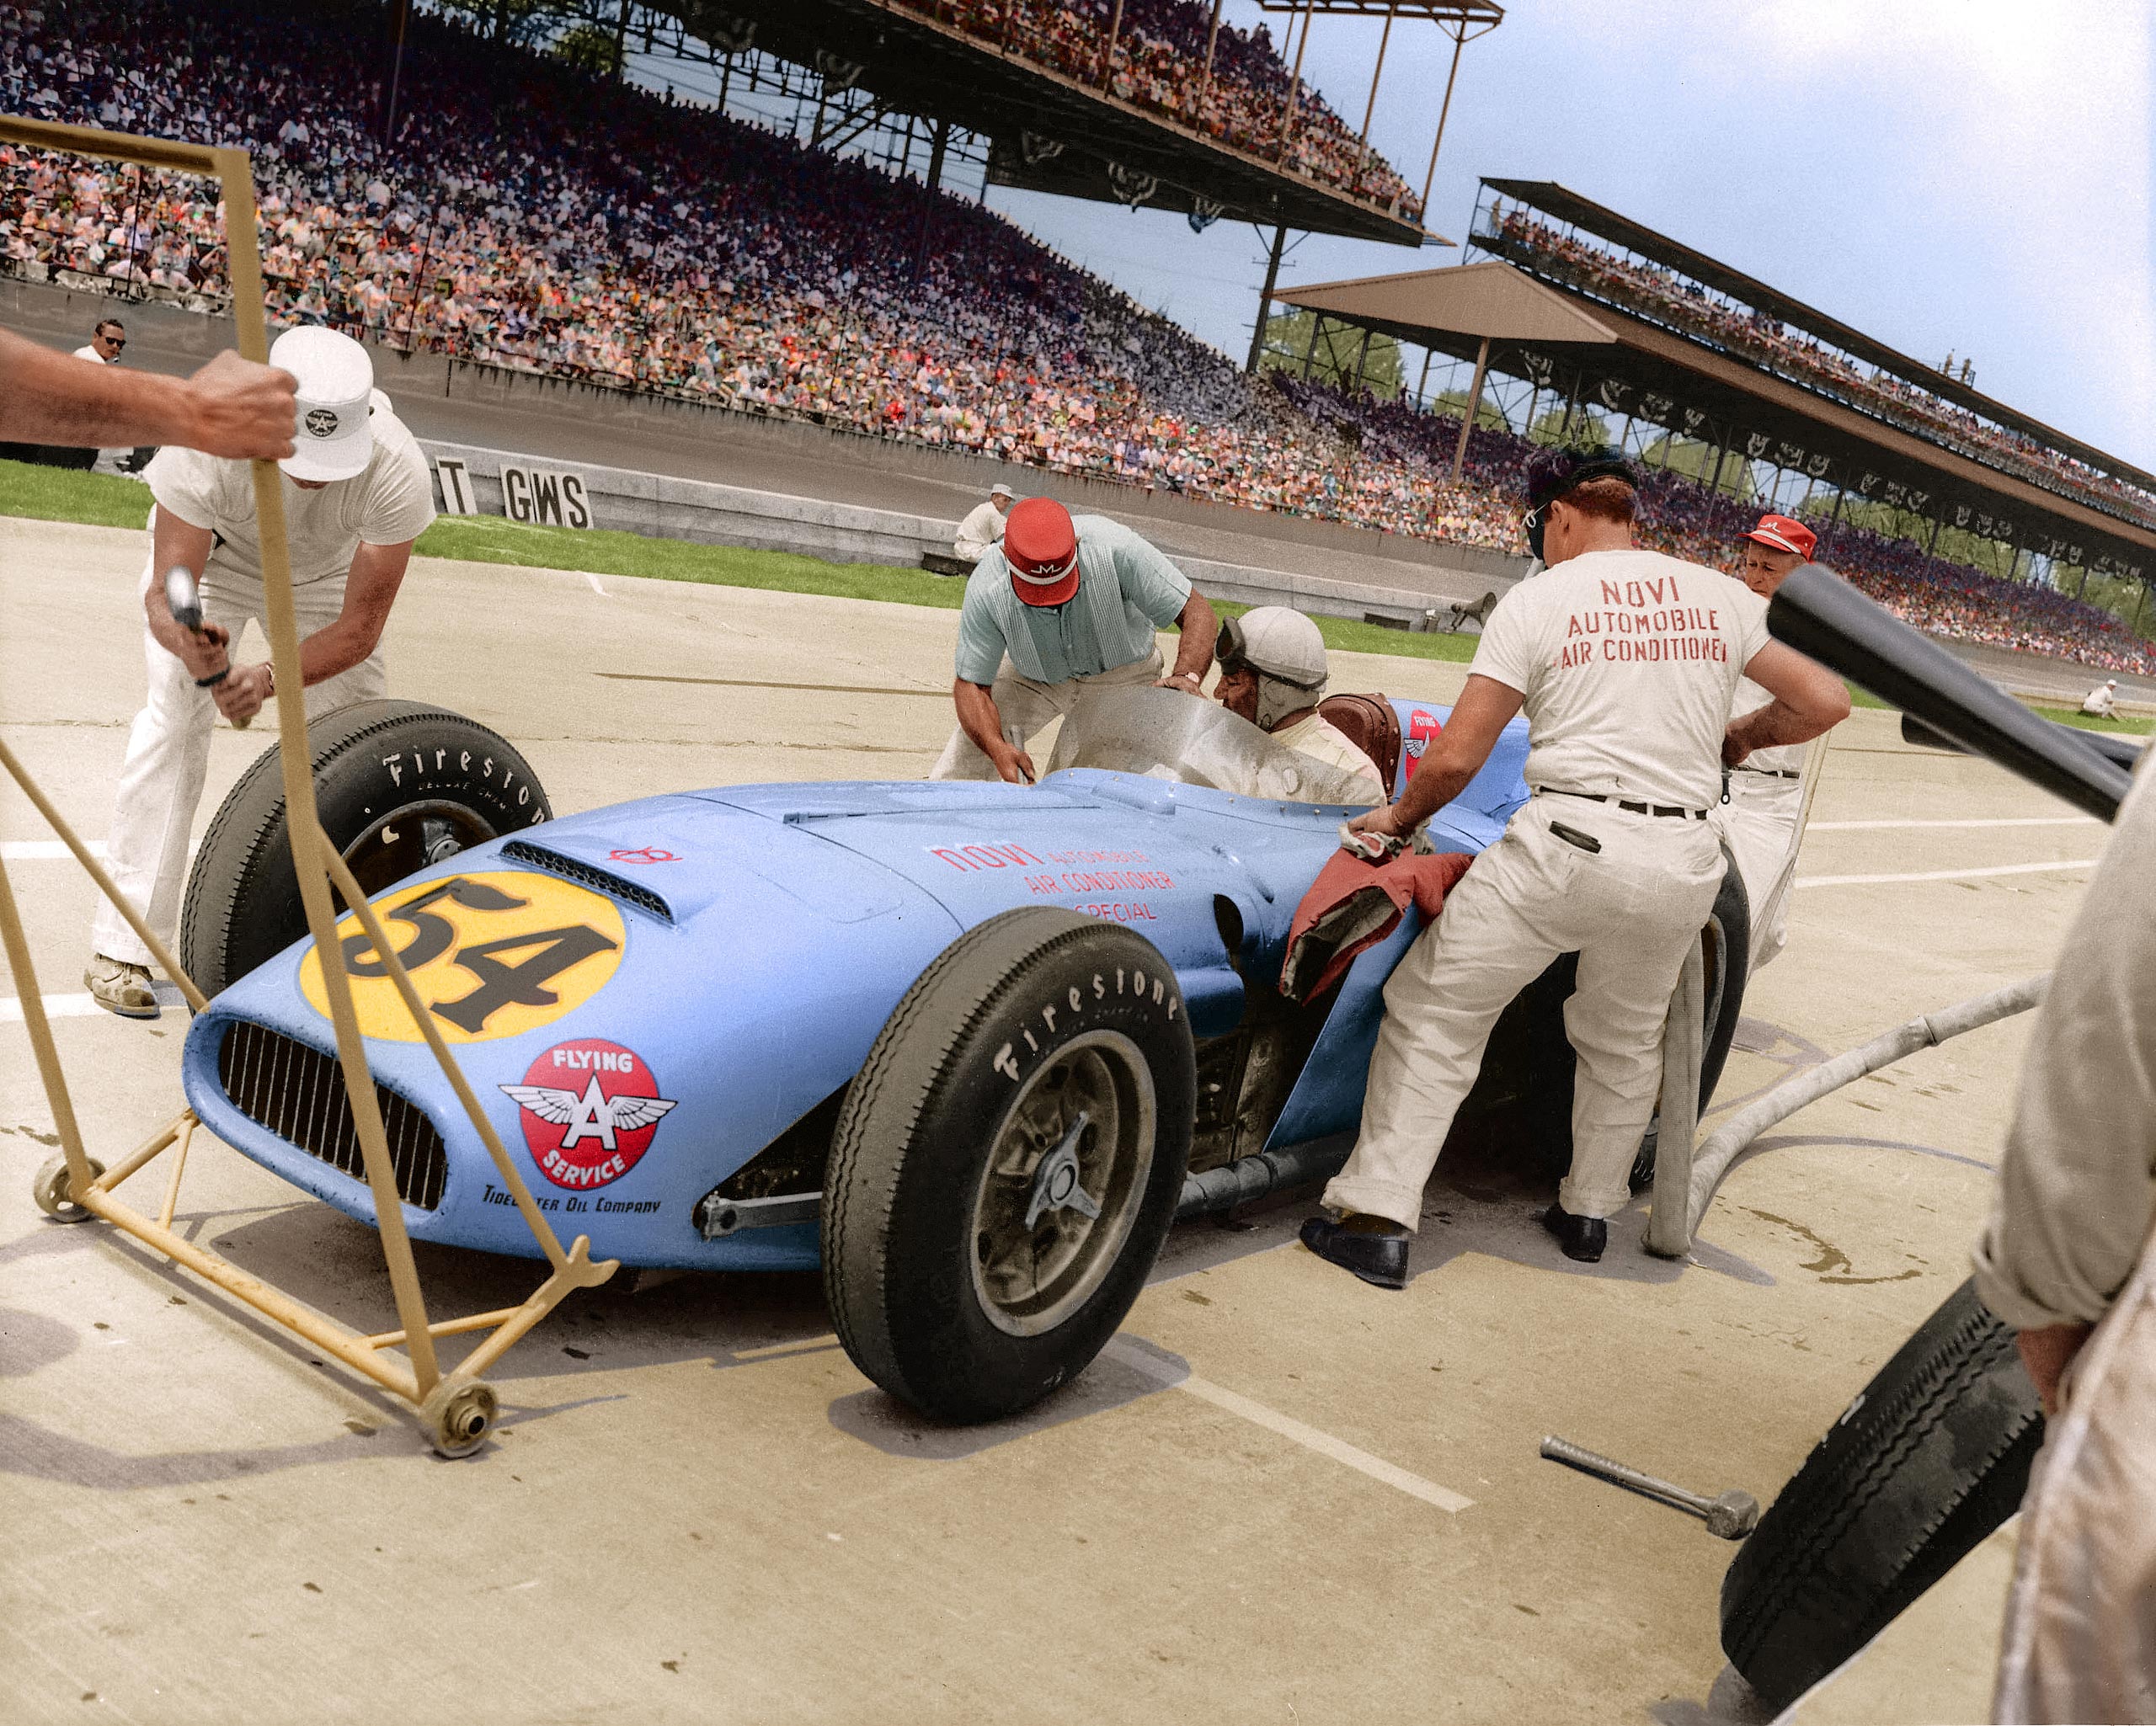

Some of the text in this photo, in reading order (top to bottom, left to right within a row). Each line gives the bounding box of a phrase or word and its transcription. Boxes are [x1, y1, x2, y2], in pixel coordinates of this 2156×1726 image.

[439, 461, 589, 529] T GWS
[1601, 576, 1680, 608] NOVI
[1567, 607, 1720, 638] AUTOMOBILE
[1561, 641, 1592, 669] AIR
[382, 744, 546, 825] Fireston
[1024, 870, 1177, 895] AIR CONDITIONER
[340, 877, 617, 1035] 54
[993, 967, 1178, 1082] Firestone
[552, 1049, 634, 1073] FLYING
[560, 1072, 618, 1150] A
[542, 1149, 627, 1186] SERVICE
